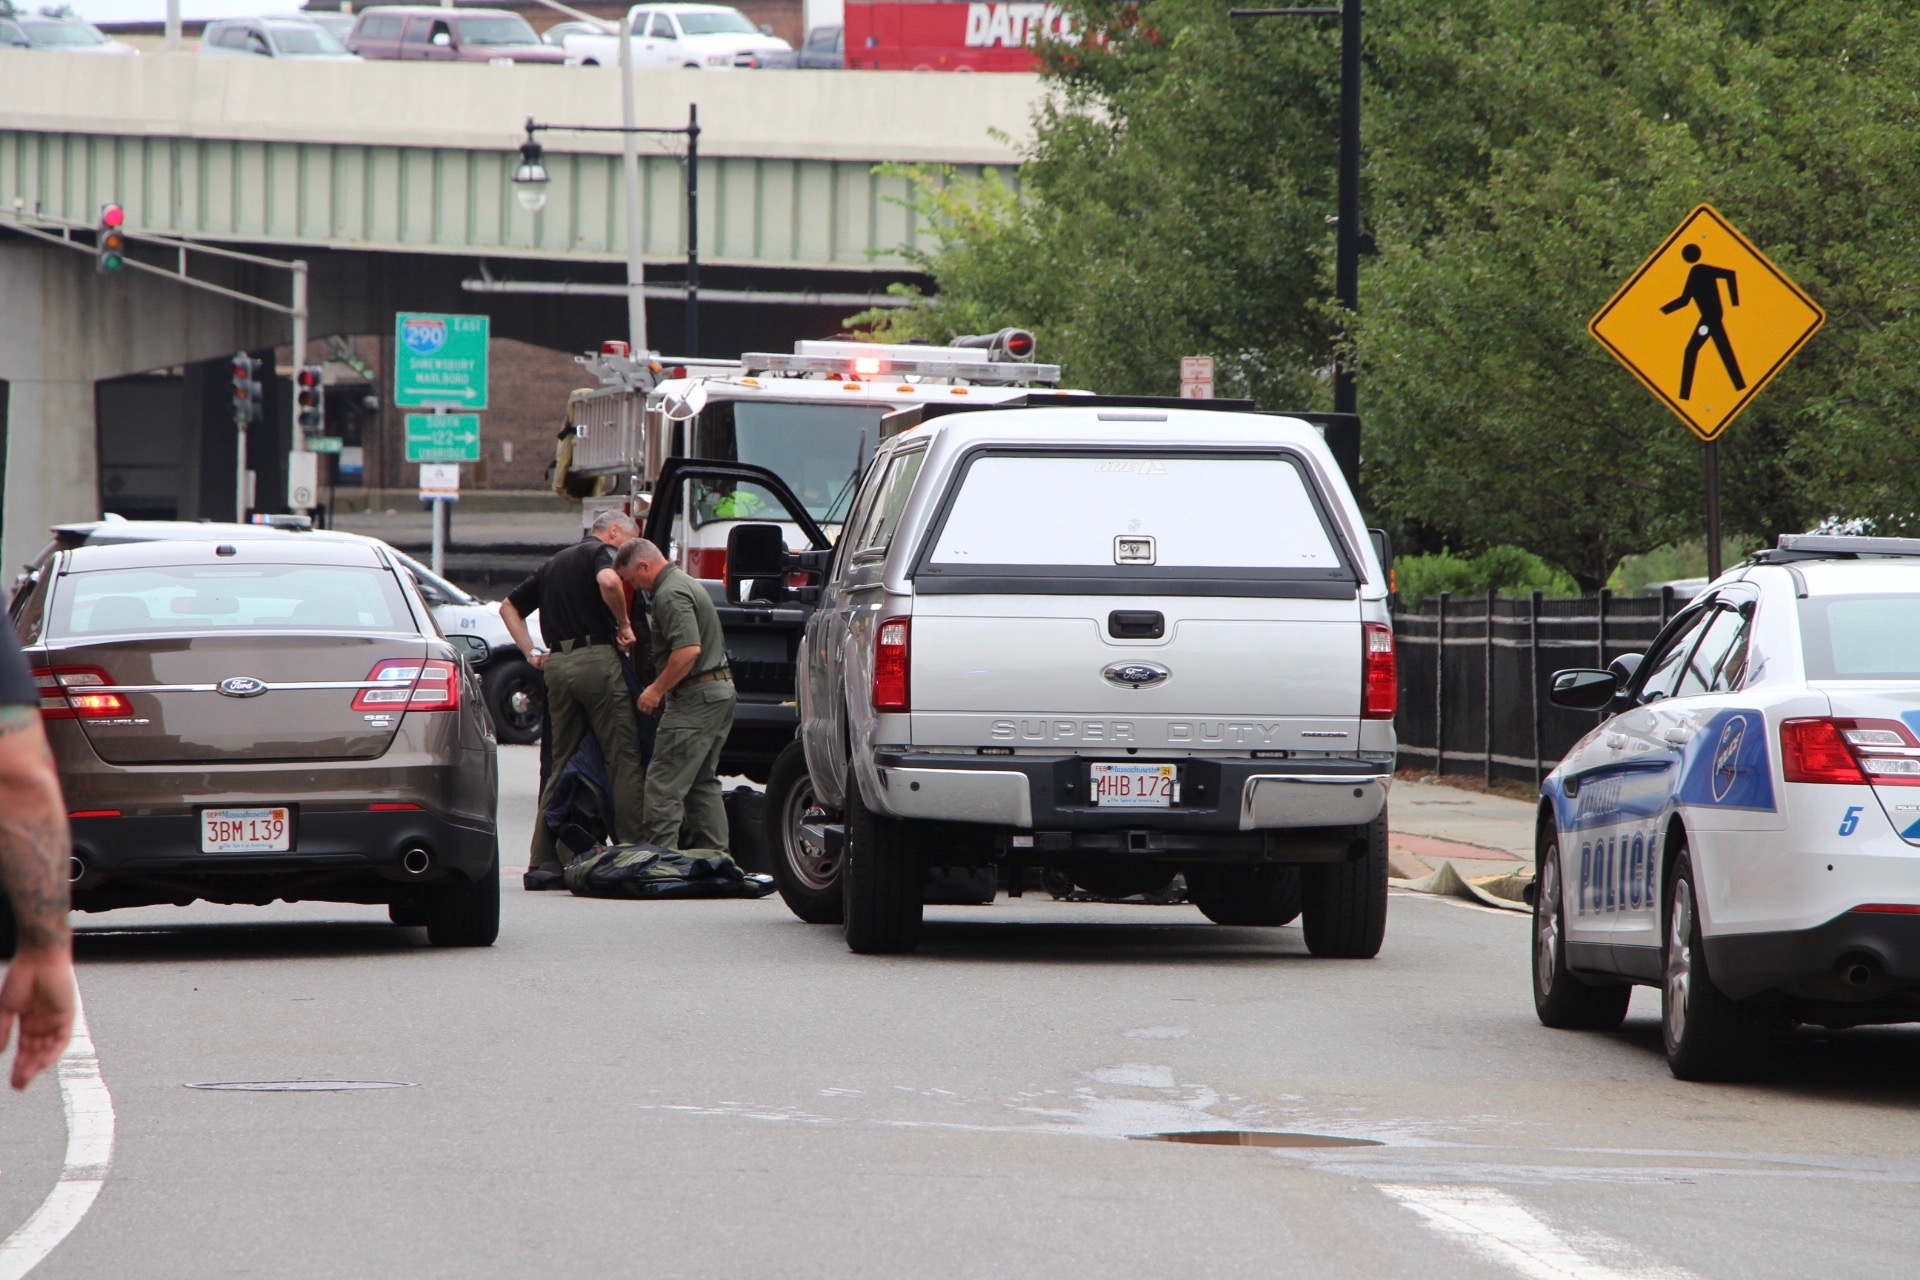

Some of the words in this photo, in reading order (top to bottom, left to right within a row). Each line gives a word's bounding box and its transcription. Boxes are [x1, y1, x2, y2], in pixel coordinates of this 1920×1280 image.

[454, 318, 481, 332] EAST
[406, 326, 443, 345] 290
[1123, 667, 1150, 680] Ford
[230, 679, 254, 690] Ford
[87, 718, 150, 726] TAURUS
[991, 719, 1136, 741] SUPER
[1167, 722, 1280, 743] DUTY
[1110, 766, 1157, 774] Massachusetts
[1098, 775, 1131, 796] 4HB
[1137, 776, 1173, 797] 172
[222, 811, 270, 819] Massachusetts
[1838, 806, 1864, 836] 5
[207, 821, 243, 842] 3BM
[249, 820, 284, 841] 139
[1579, 829, 1657, 916] POLICE
